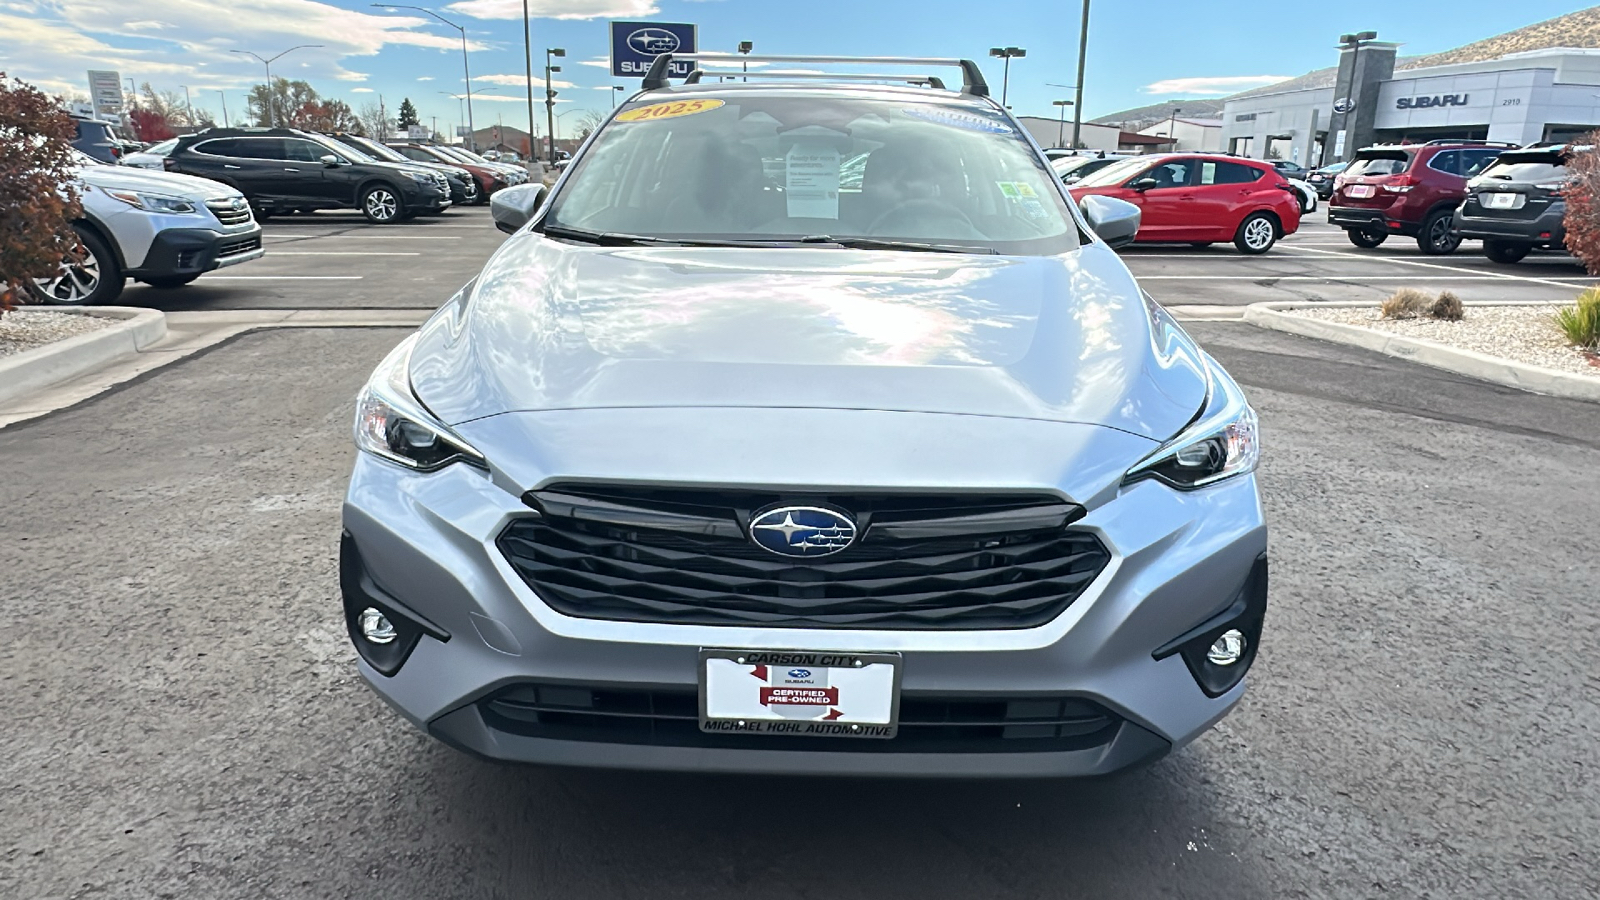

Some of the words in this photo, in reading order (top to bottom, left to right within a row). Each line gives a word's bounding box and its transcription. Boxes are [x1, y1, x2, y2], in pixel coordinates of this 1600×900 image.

[621, 61, 688, 74] SUBRU
[1396, 94, 1468, 109] SUBARU
[634, 100, 706, 120] 2025
[747, 653, 816, 664] CARSON
[820, 655, 858, 666] CITY
[773, 689, 825, 697] CERTIFIED
[768, 696, 830, 704] PRE-OWNED
[704, 720, 763, 732] MICHAEL
[766, 722, 801, 733] HOHL
[805, 723, 893, 736] AUTOMOTIVE
